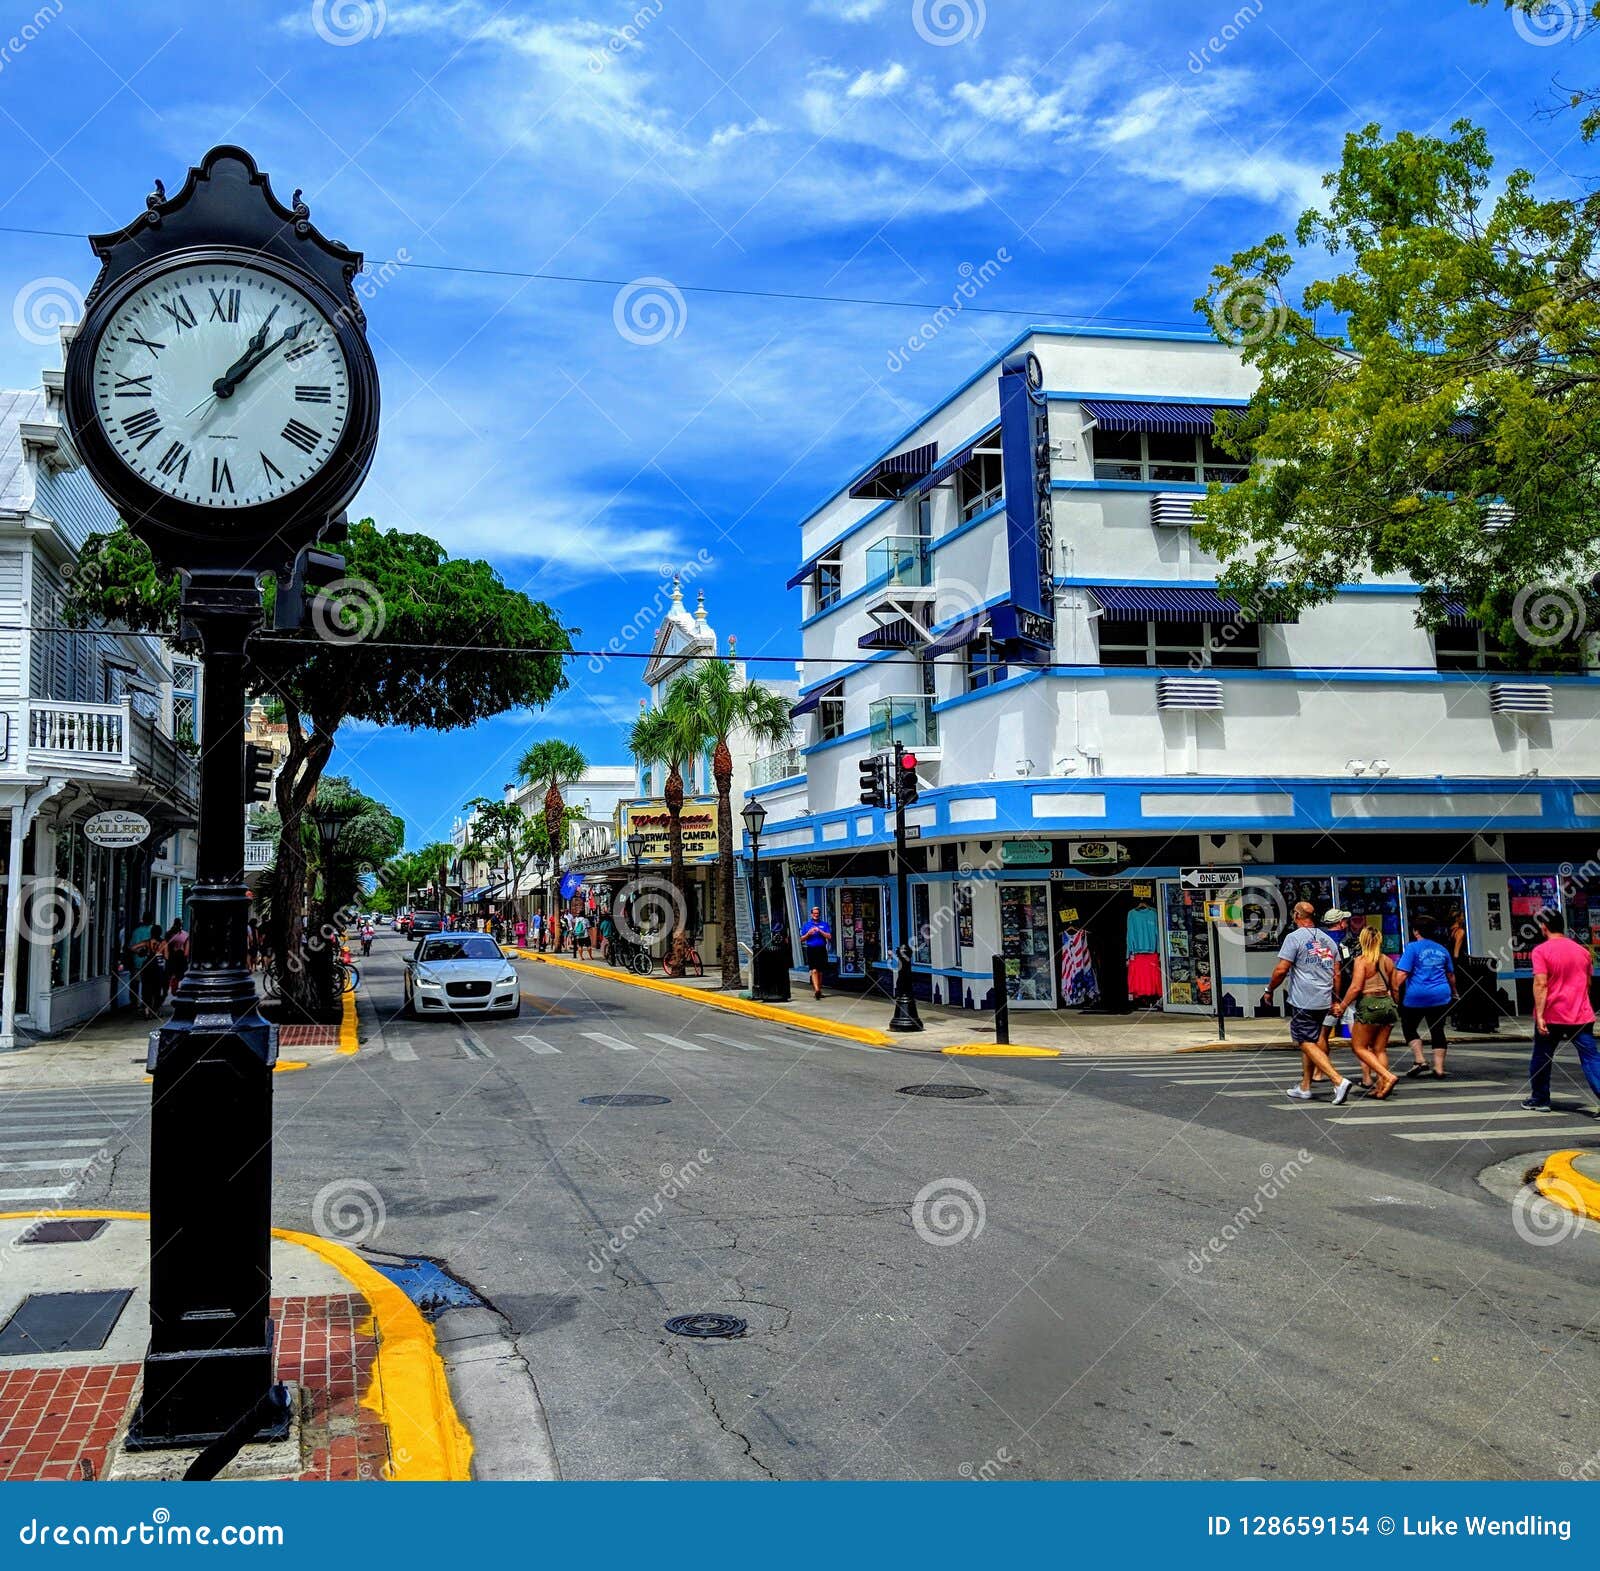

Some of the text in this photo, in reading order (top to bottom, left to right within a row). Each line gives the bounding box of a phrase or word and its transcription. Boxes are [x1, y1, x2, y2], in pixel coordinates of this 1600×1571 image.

[161, 294, 198, 335] XI
[208, 288, 241, 323] XII
[126, 328, 166, 359] X
[114, 372, 152, 398] IX
[295, 386, 331, 403] III
[121, 408, 165, 451] VIII
[156, 441, 192, 483] VII
[212, 456, 235, 493] VI
[260, 450, 285, 485] V
[85, 824, 148, 834] GALLERY
[631, 813, 713, 828] Walgeens
[664, 843, 704, 852] SPLIES
[682, 831, 717, 840] CAMERA
[1050, 870, 1064, 878] 537
[1200, 873, 1237, 883] ONE WAY
